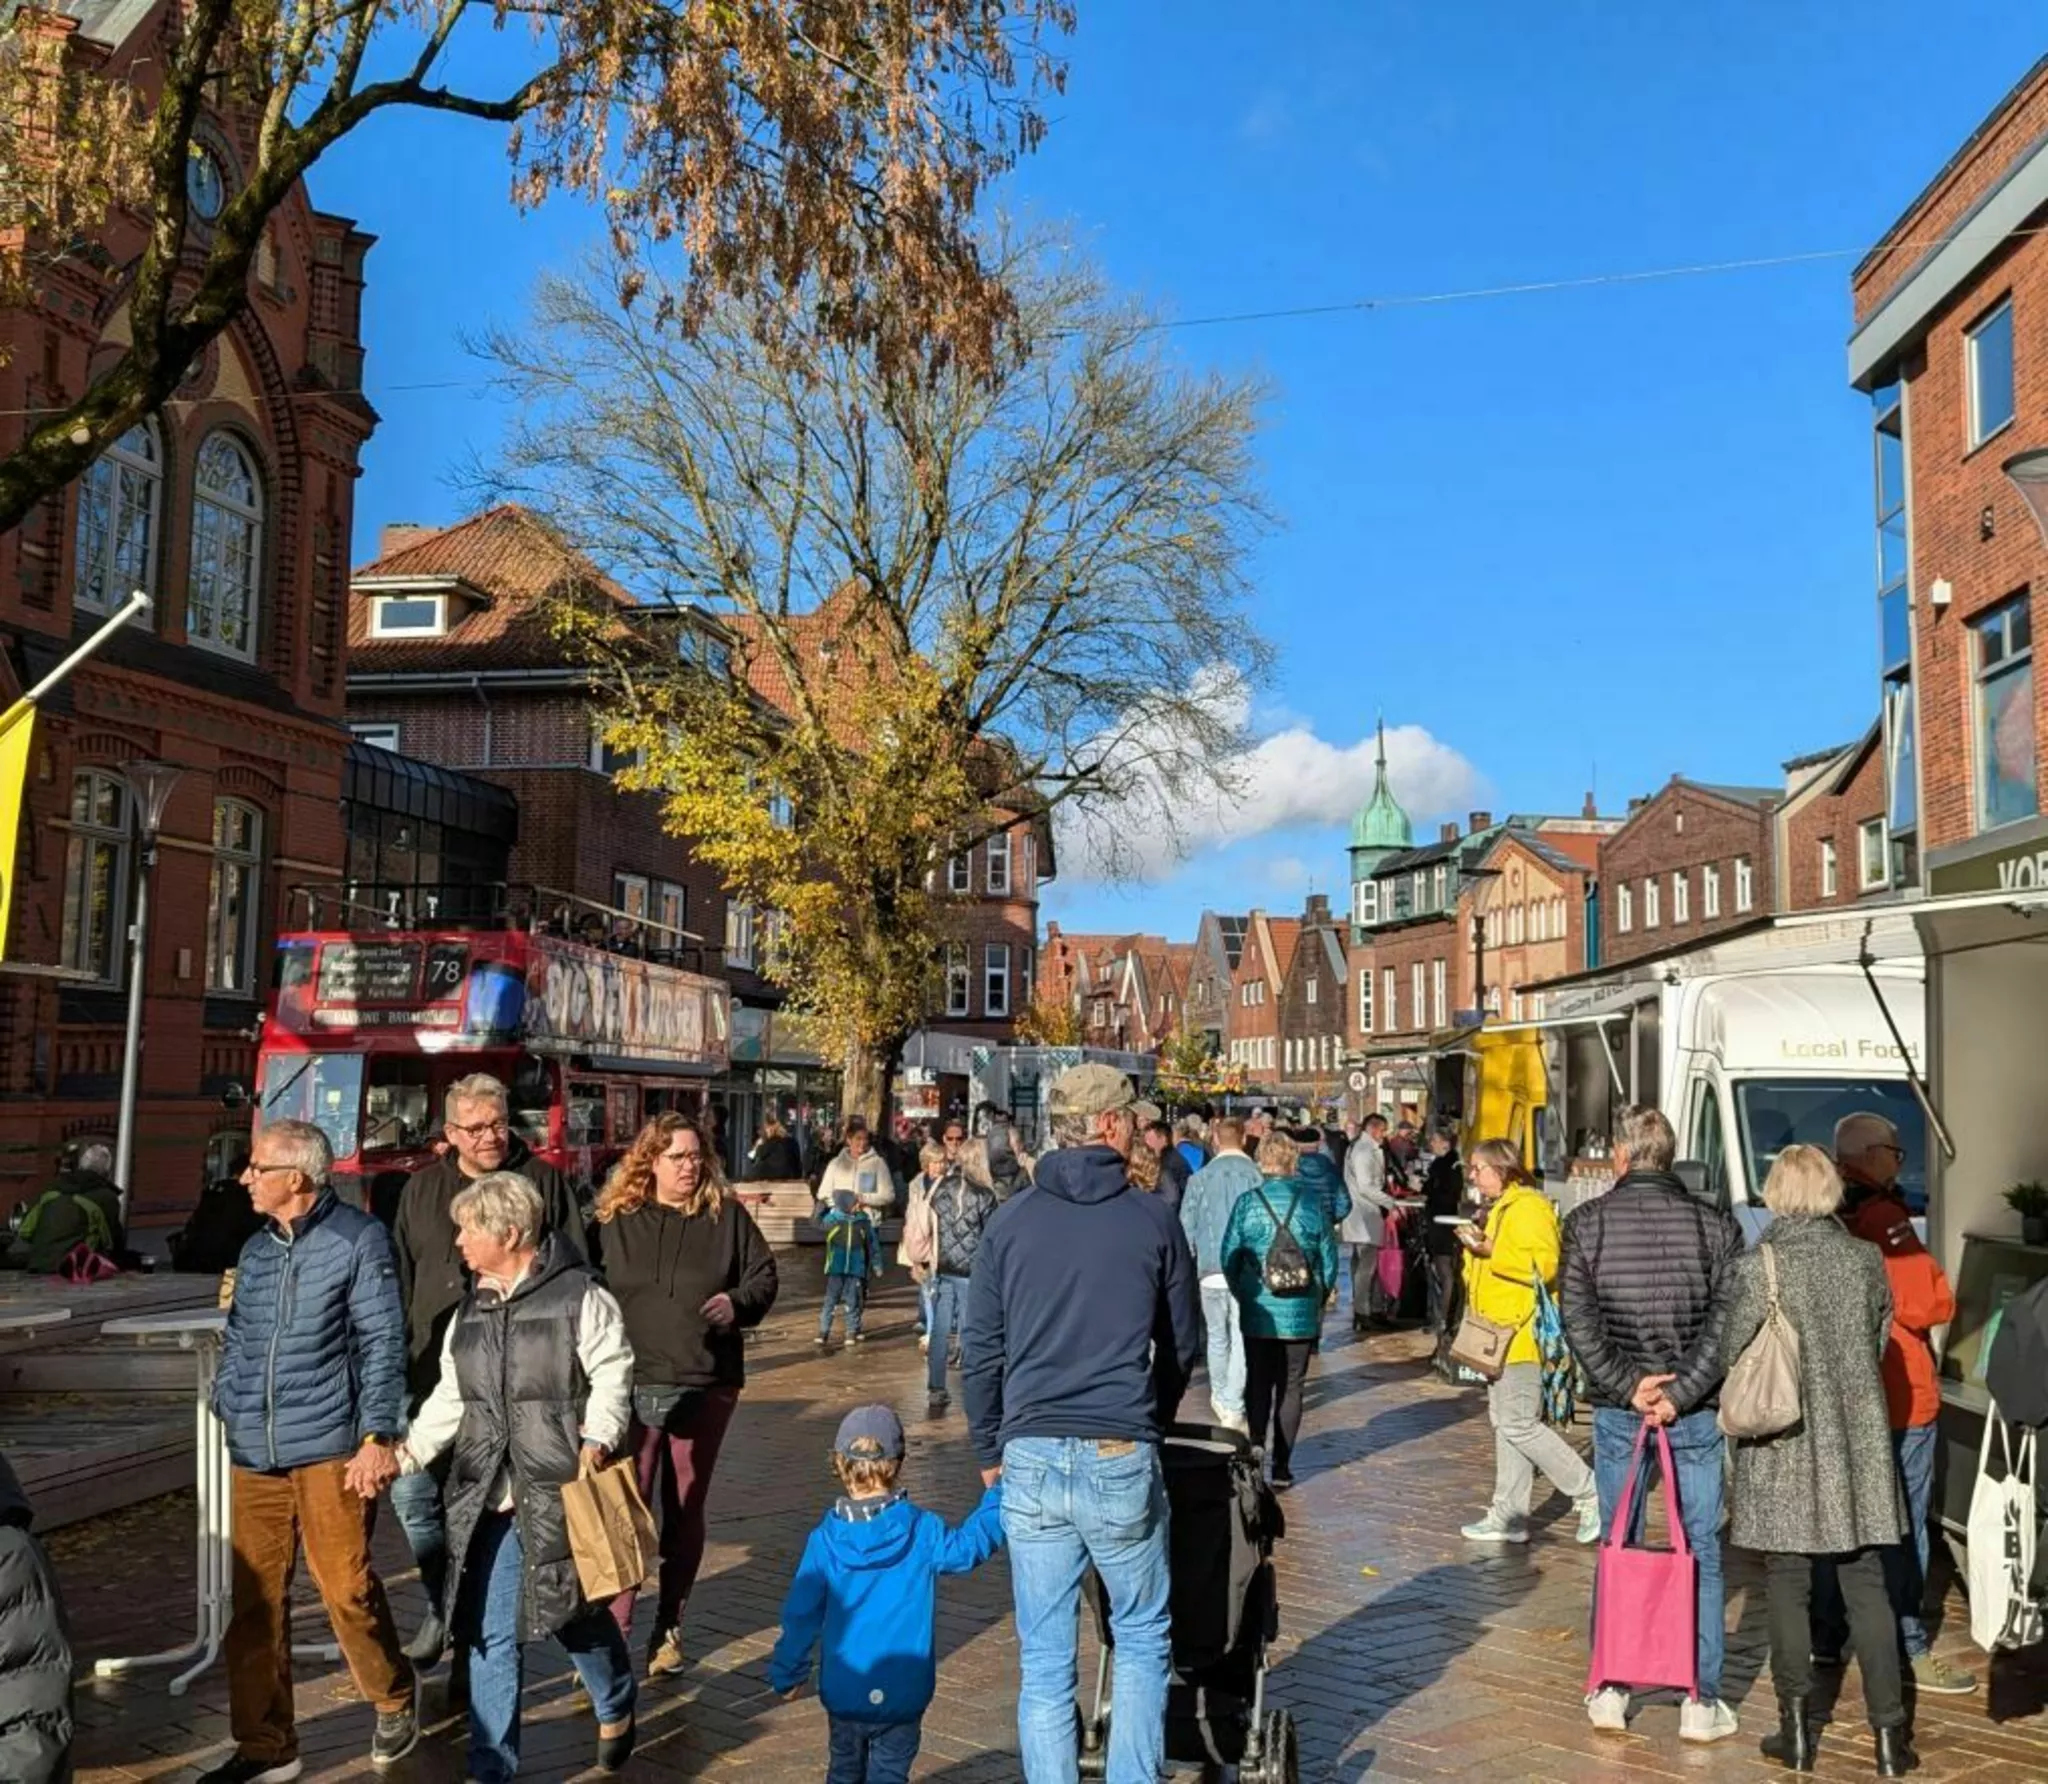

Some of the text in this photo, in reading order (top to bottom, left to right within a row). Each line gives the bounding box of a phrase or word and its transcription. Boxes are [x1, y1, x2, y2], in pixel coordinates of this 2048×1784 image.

[430, 960, 461, 983] 78
[1781, 1039, 1919, 1059] Local Food
